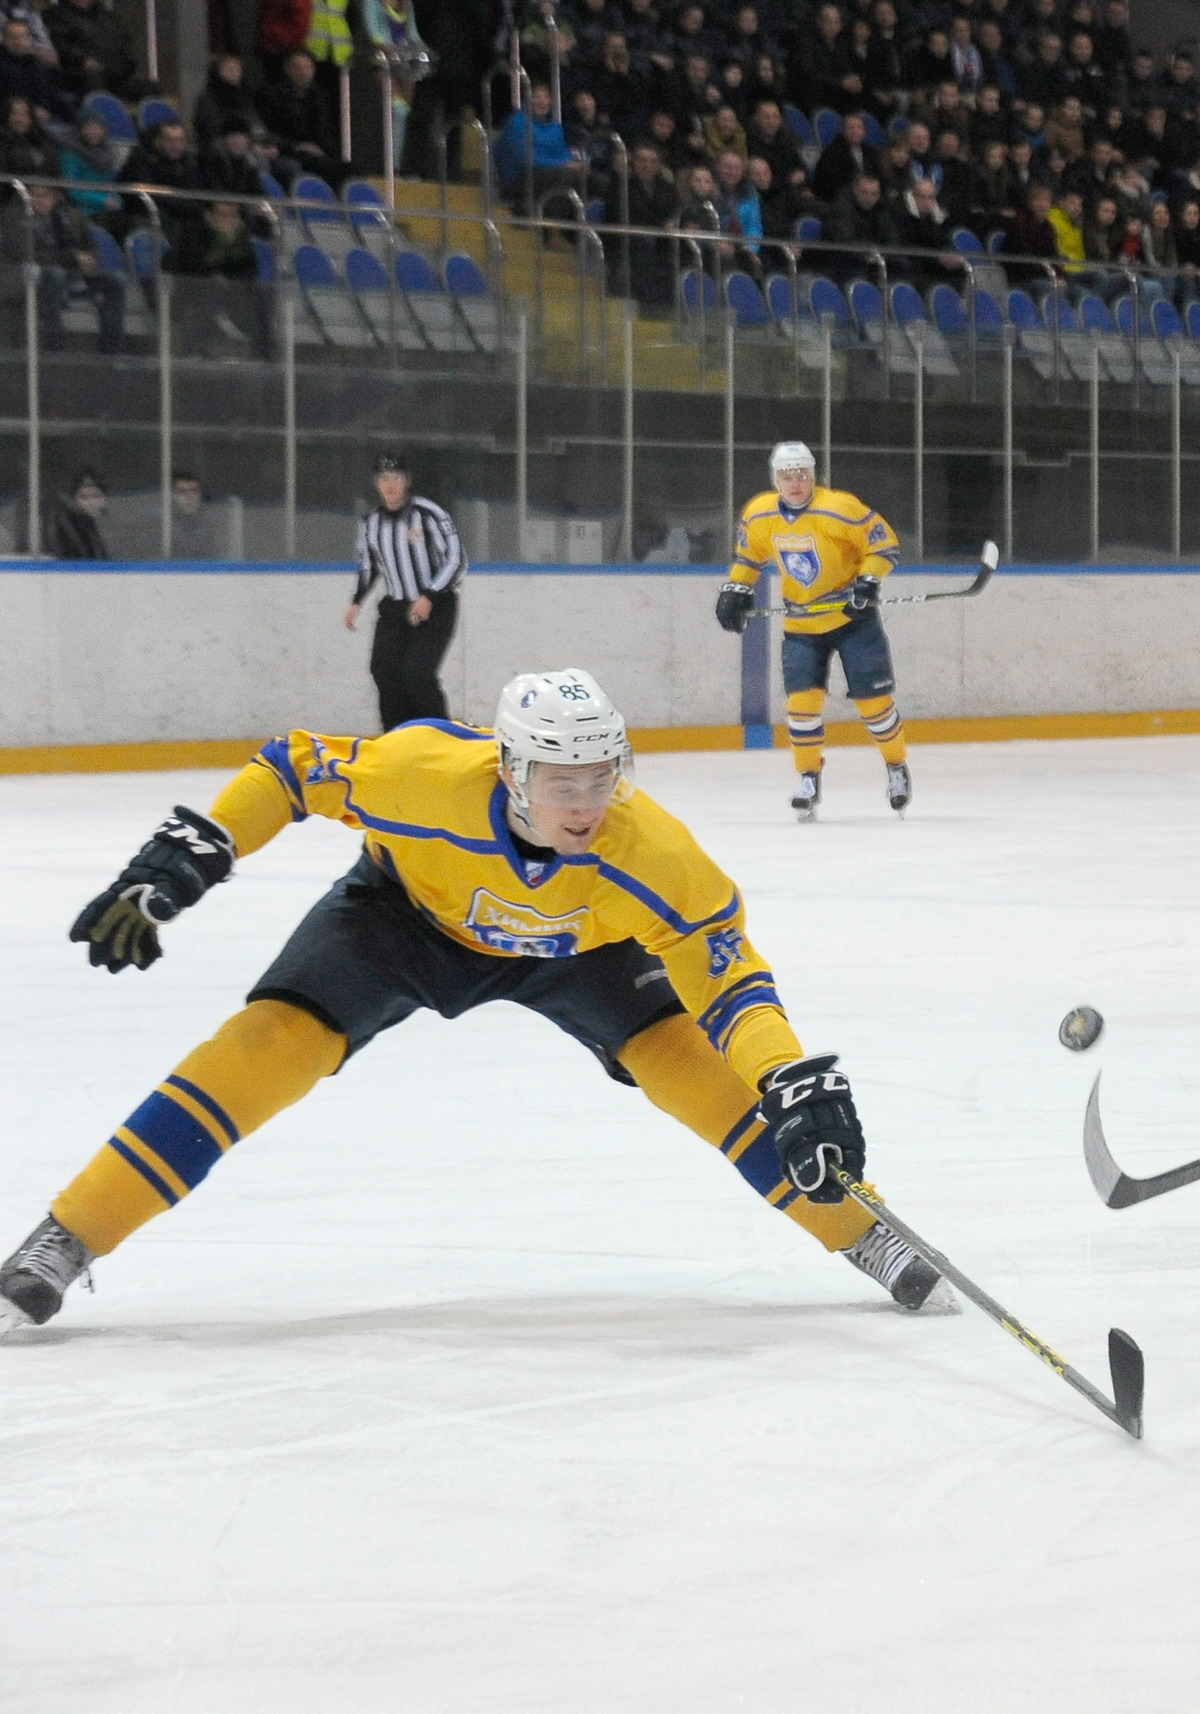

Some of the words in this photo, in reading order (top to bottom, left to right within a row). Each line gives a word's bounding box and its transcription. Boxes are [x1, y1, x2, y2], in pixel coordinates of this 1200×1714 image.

[559, 684, 590, 701] 85
[573, 733, 610, 743] CCM
[850, 1182, 879, 1205] CCM
